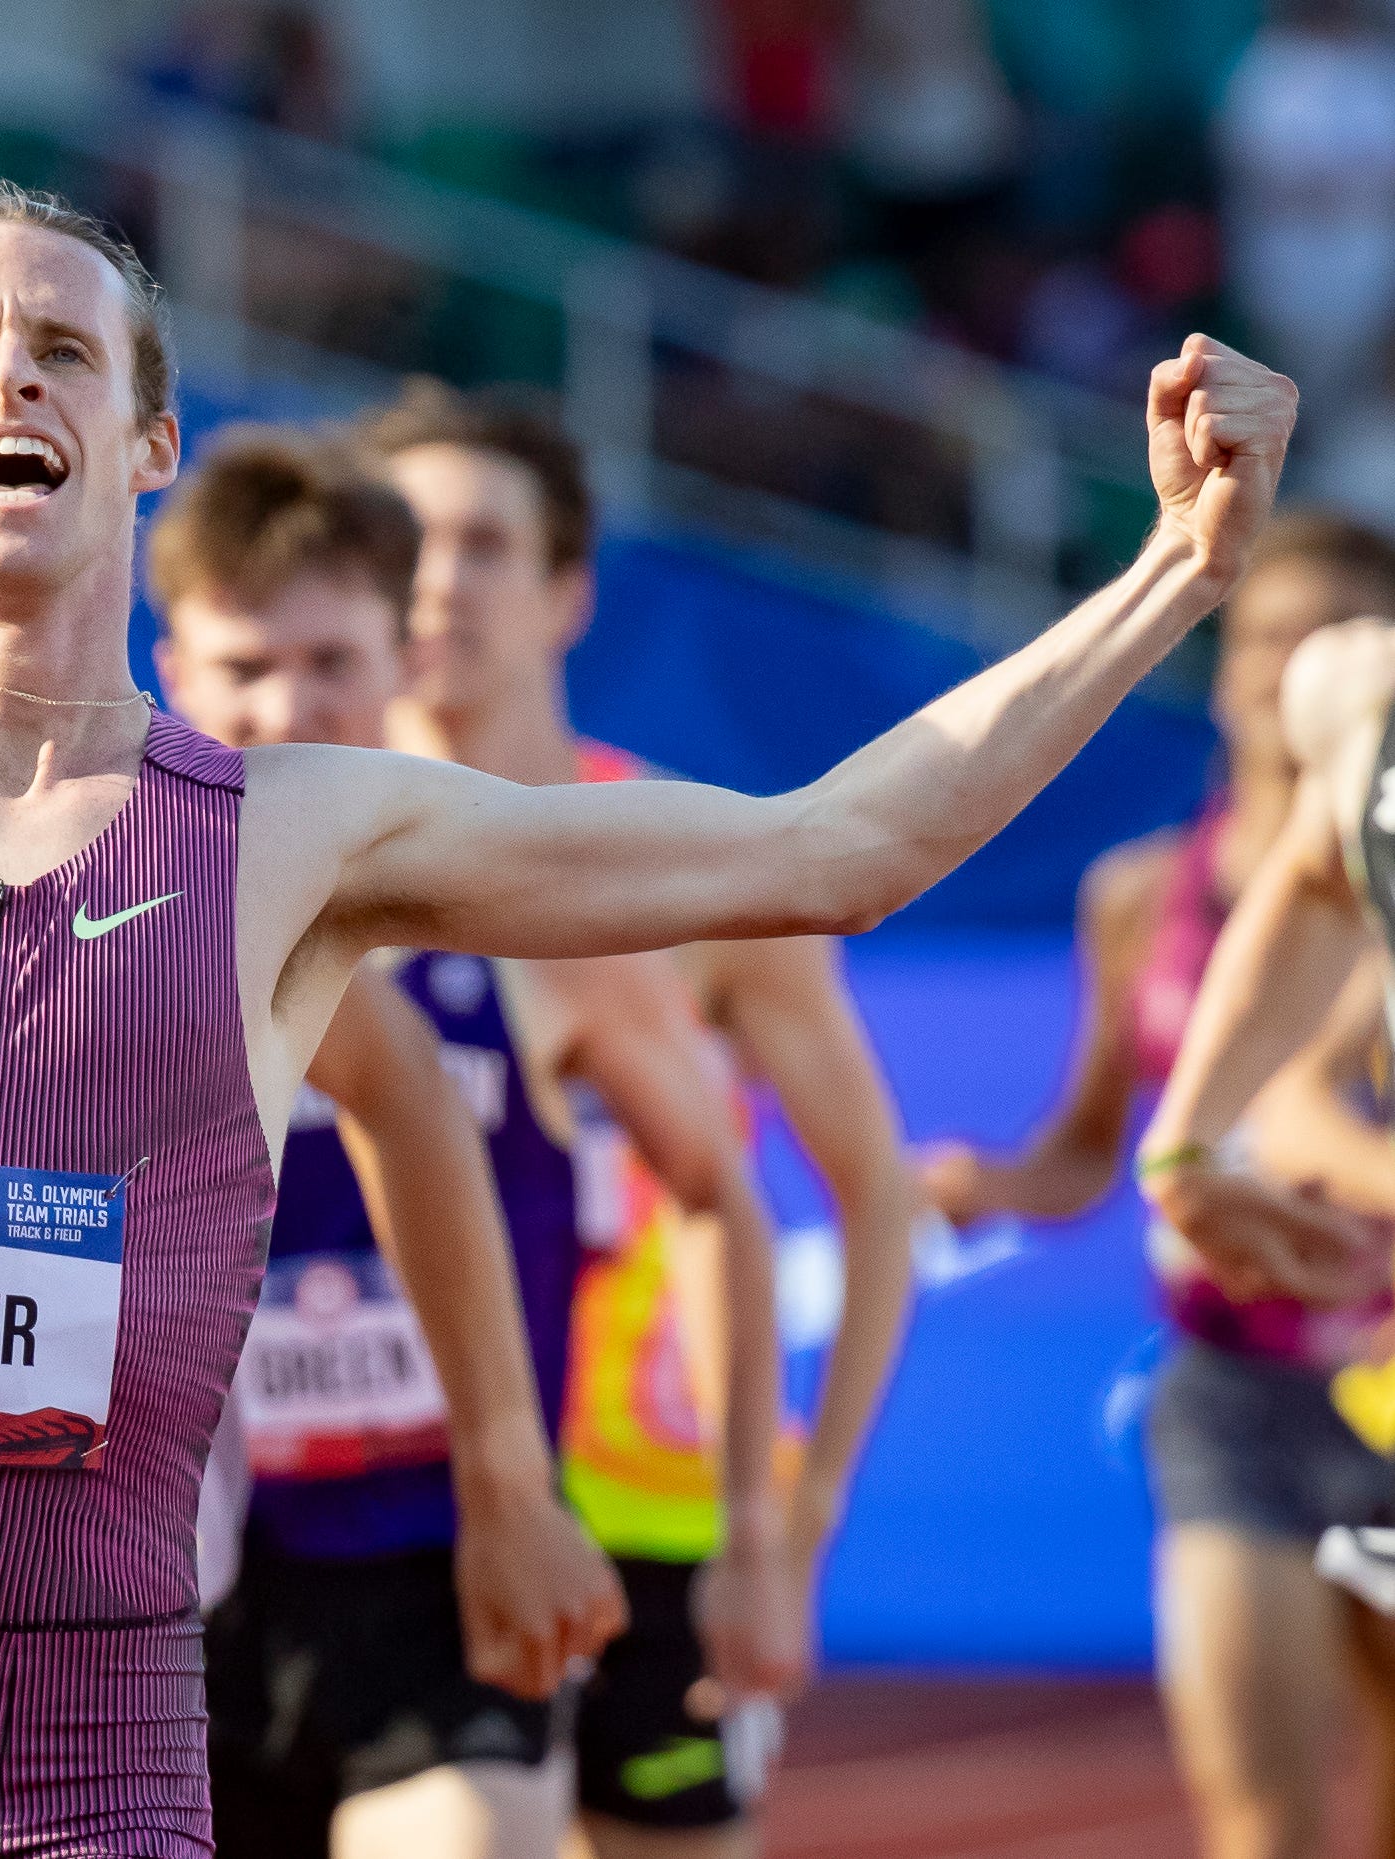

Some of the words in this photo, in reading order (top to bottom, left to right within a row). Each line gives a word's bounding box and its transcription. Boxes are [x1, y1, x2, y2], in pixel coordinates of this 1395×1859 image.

[8, 1181, 37, 1202] U.S.
[42, 1185, 108, 1207] OLYMPIC
[6, 1203, 48, 1224] TEAM
[53, 1206, 108, 1228] TRIALS
[7, 1224, 41, 1239] TRACK
[54, 1228, 82, 1242] FIELD
